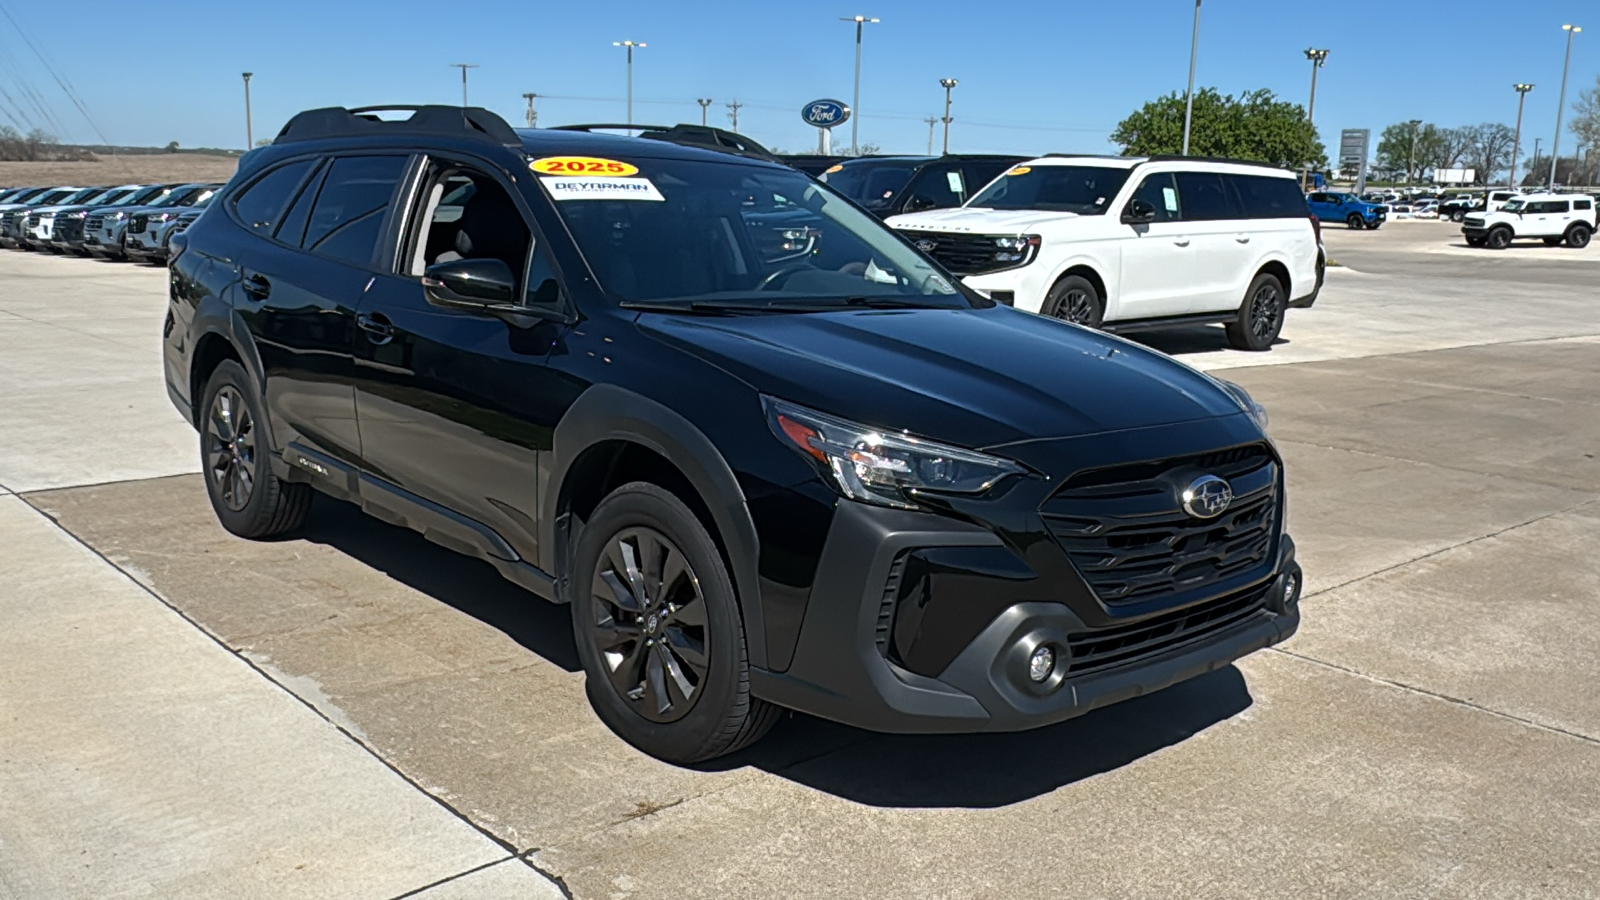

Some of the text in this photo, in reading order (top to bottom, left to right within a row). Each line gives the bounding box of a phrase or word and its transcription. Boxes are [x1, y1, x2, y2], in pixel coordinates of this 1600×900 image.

[809, 104, 837, 121] Ford
[546, 161, 625, 173] 2025
[555, 182, 649, 191] DEYARMAN
[897, 223, 971, 231] EXPEDITION
